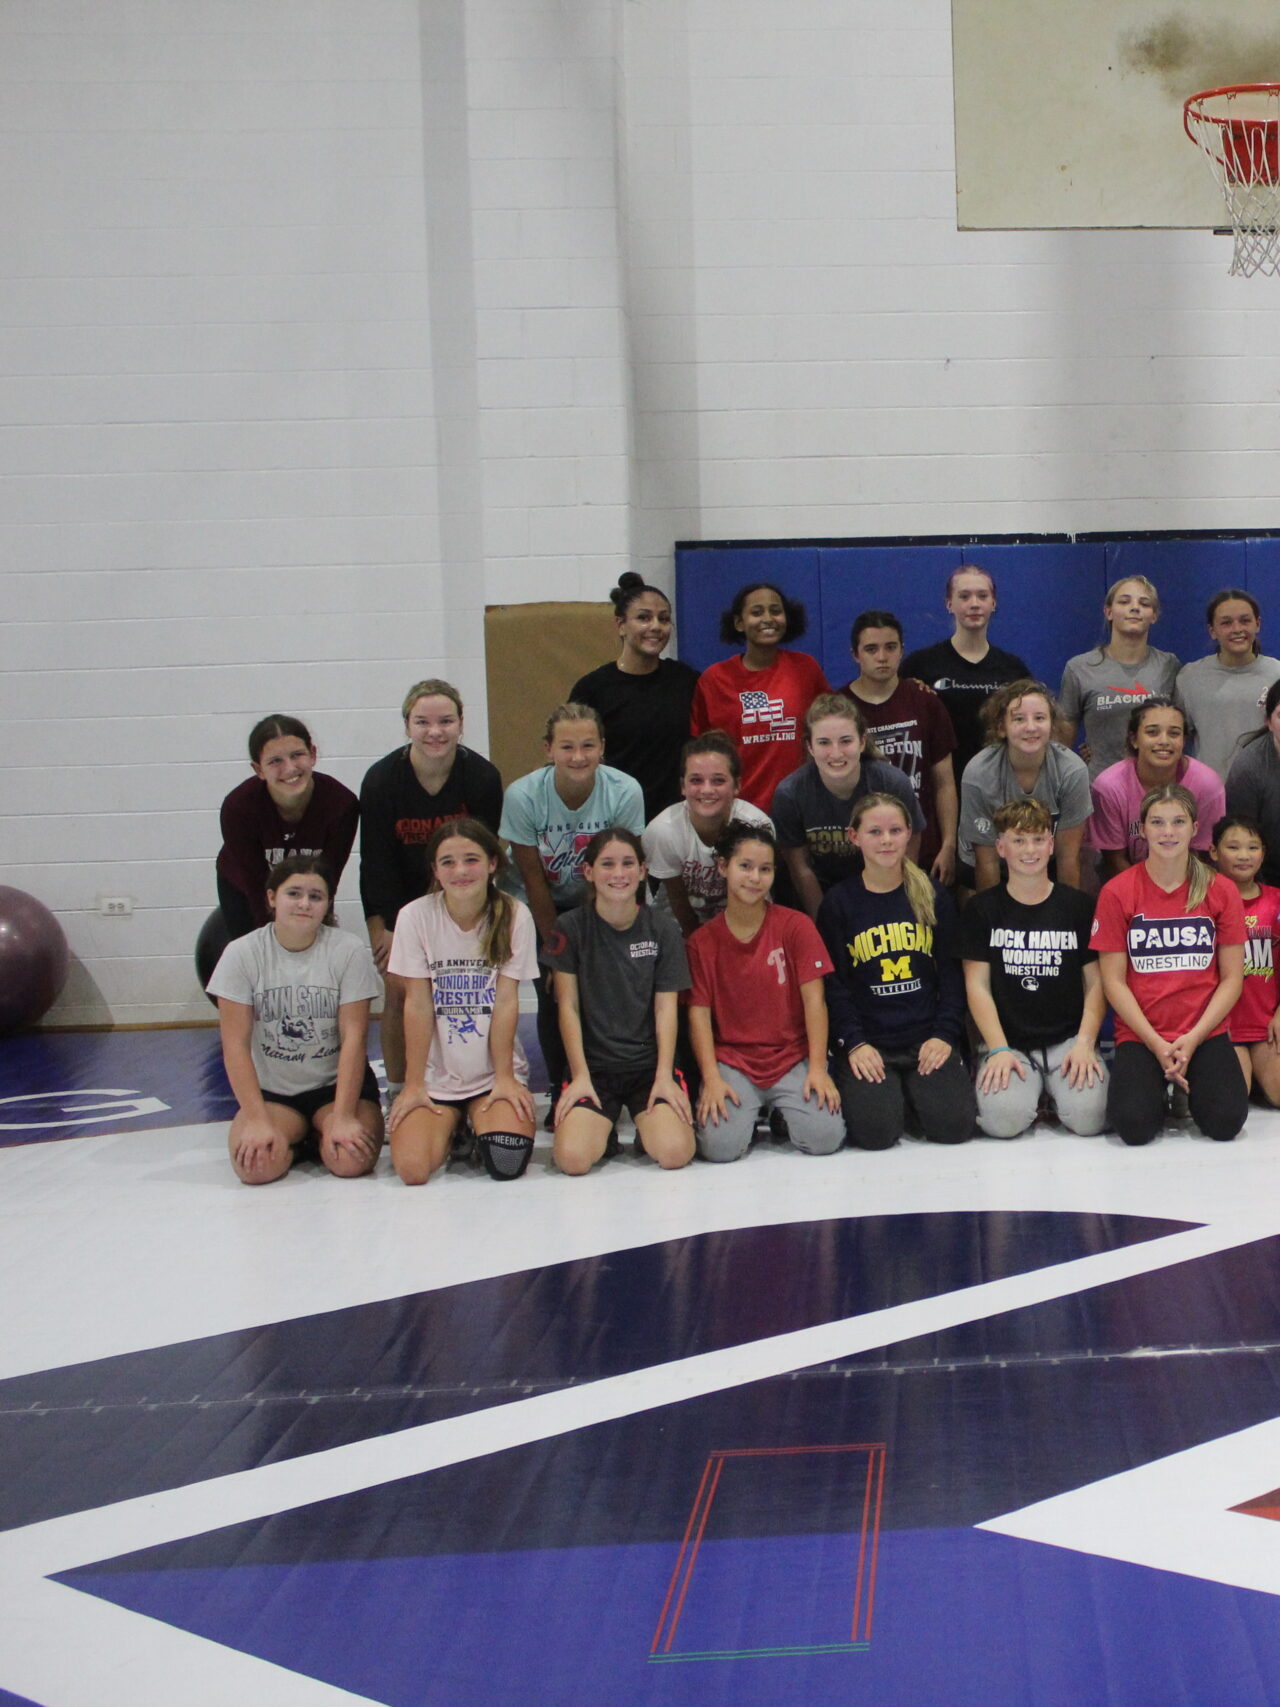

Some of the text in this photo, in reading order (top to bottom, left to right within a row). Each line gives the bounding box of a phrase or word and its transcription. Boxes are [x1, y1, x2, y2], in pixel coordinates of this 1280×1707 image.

[934, 678, 1005, 694] Champi
[742, 732, 796, 745] WRESTLING
[578, 820, 609, 829] GUNS
[846, 921, 934, 968] MICHIGAN
[1028, 931, 1078, 949] HAVEN
[1130, 926, 1212, 949] PAUSA
[1002, 948, 1062, 965] WOMEN'S
[1134, 956, 1208, 970] WRESTLING
[880, 955, 913, 981] M
[1004, 963, 1060, 976] WRESTLING
